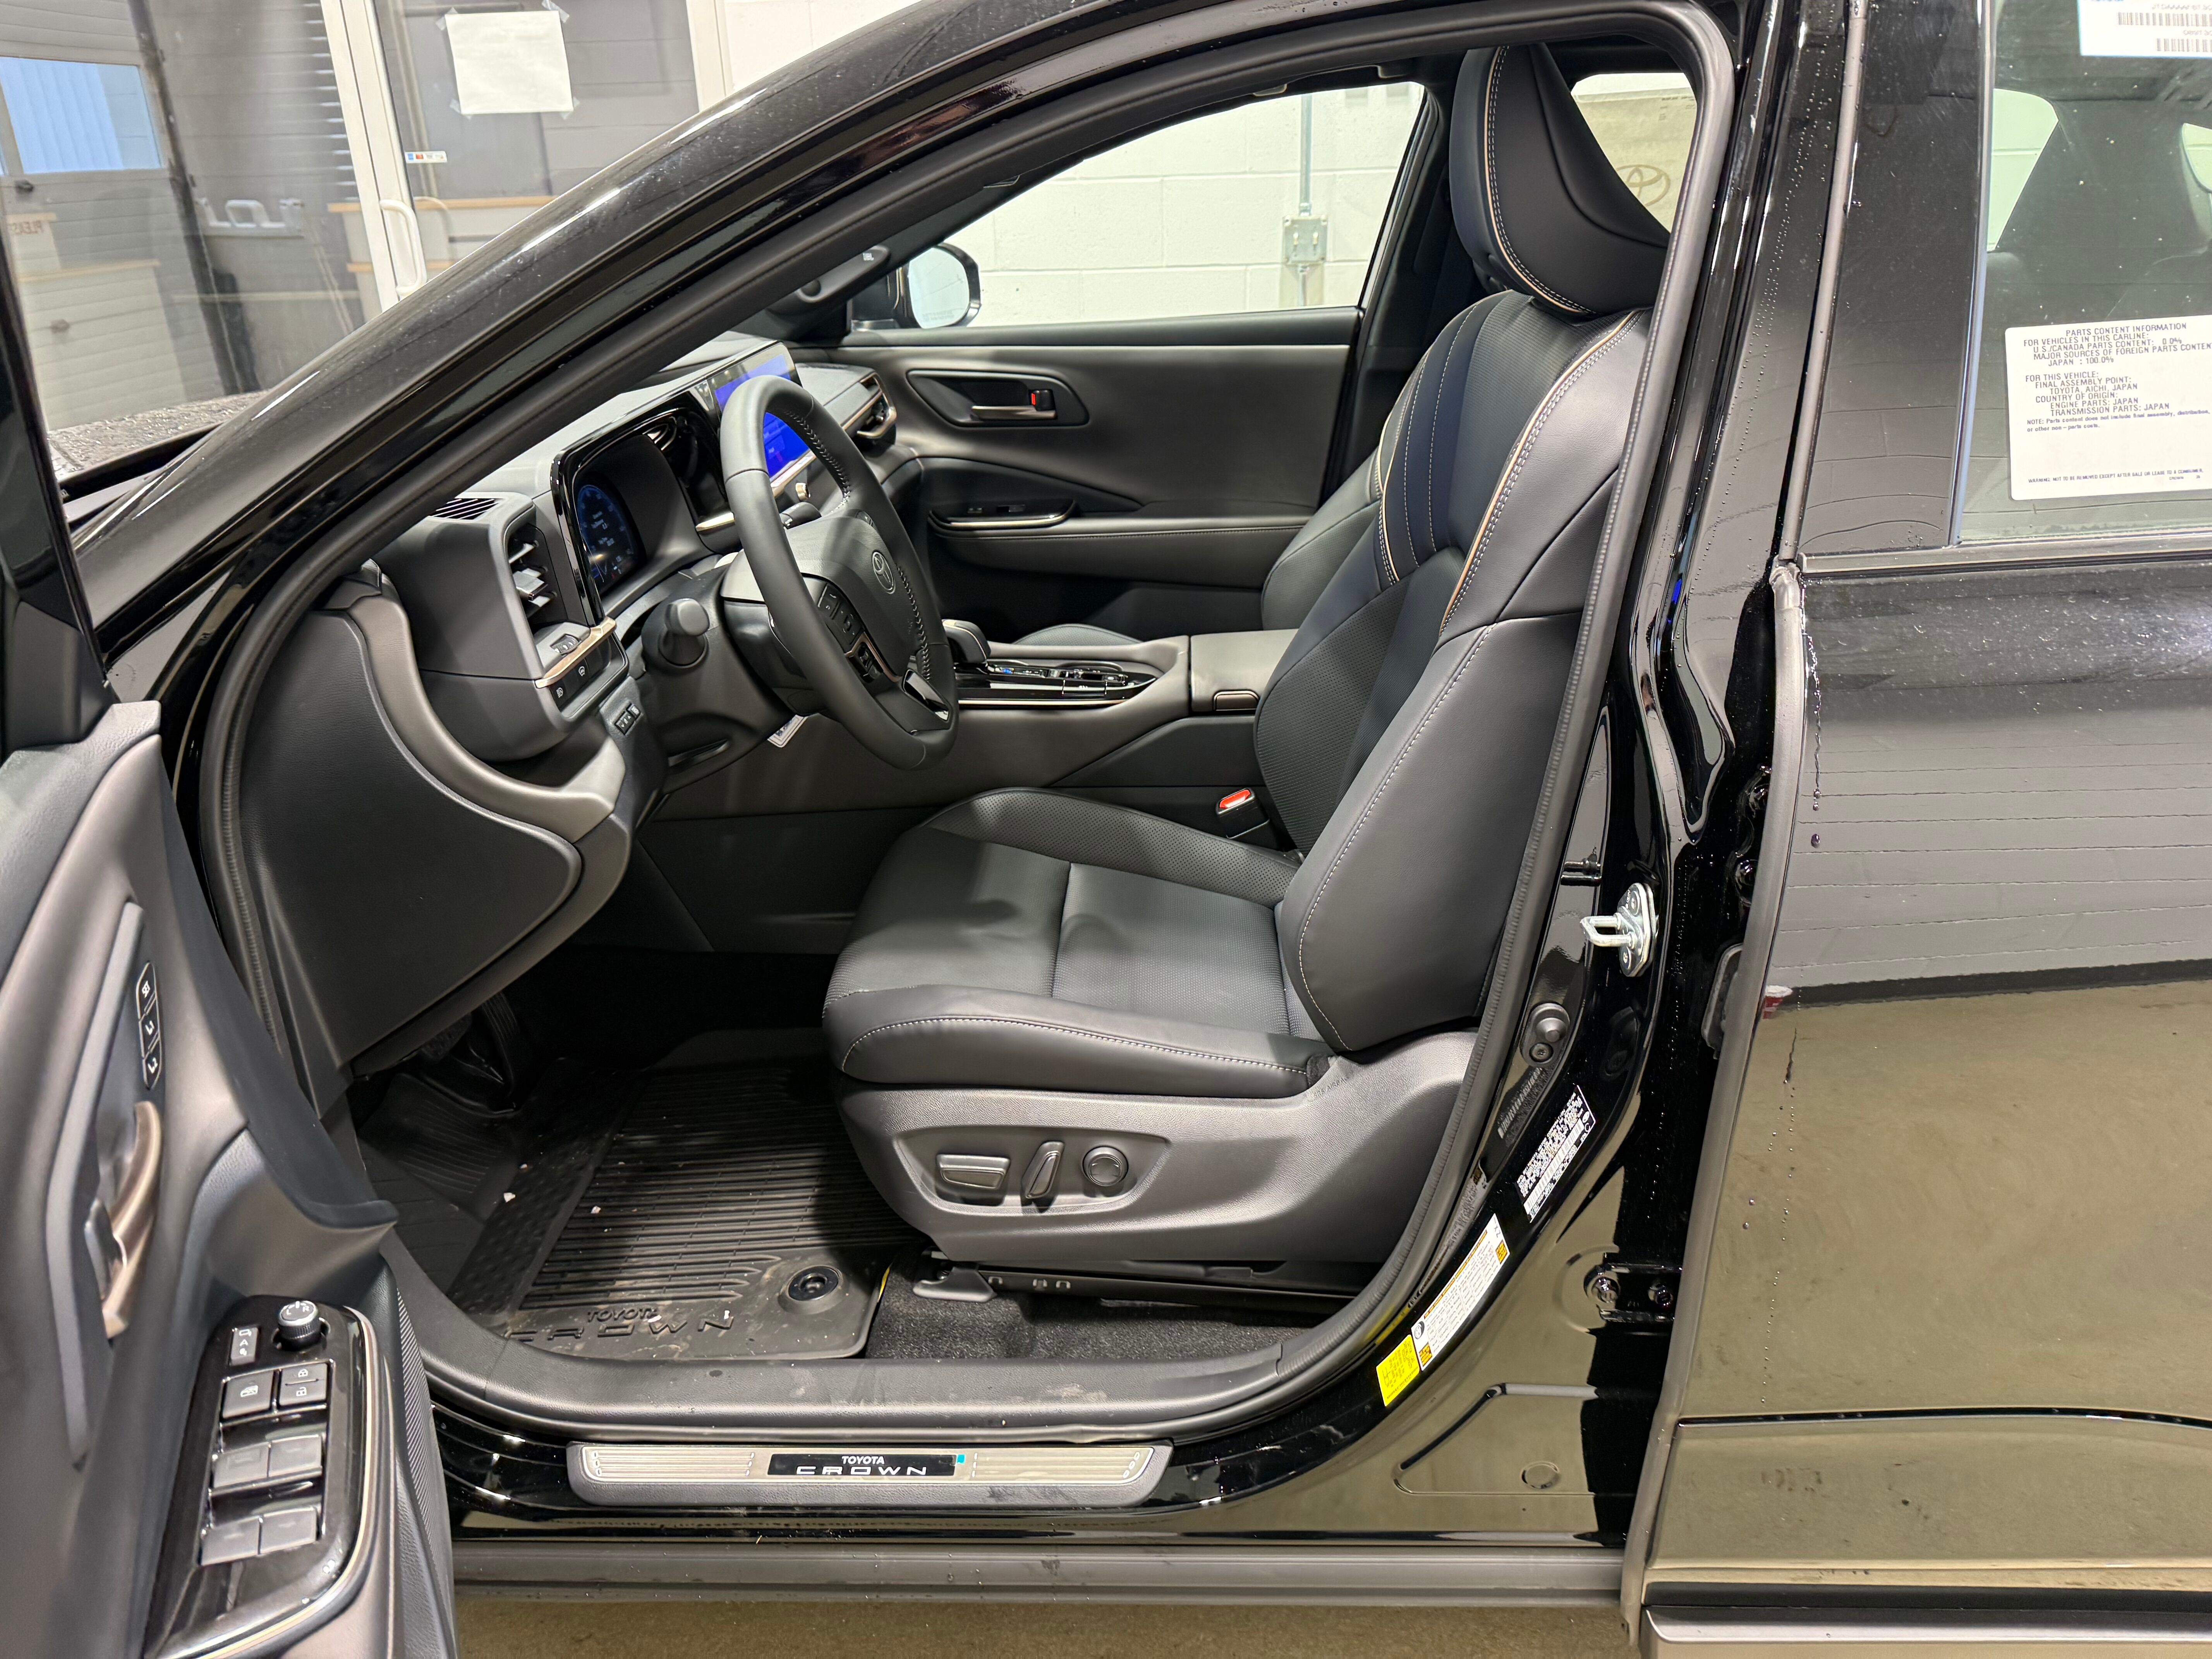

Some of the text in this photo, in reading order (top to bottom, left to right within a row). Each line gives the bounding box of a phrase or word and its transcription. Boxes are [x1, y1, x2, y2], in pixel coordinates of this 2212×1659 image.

[2094, 326, 2130, 335] CONTENT
[2133, 323, 2186, 332] INFORMATION
[2042, 337, 2078, 345] VEHICLES
[2113, 332, 2149, 340] CARLINE:
[2116, 339, 2154, 347] CONTENT:
[2064, 349, 2100, 358] SOURCES
[2116, 347, 2149, 355] FOREIGN
[2152, 345, 2178, 353] PARTS
[2064, 371, 2099, 380] VEHICLE:
[2060, 378, 2102, 386] ASSEMBLY
[2036, 394, 2072, 403] COUNTRY
[2051, 406, 2110, 416] TRANSMISSION
[841, 1456, 885, 1465] TOYOTA
[796, 1466, 927, 1475] CROWN
